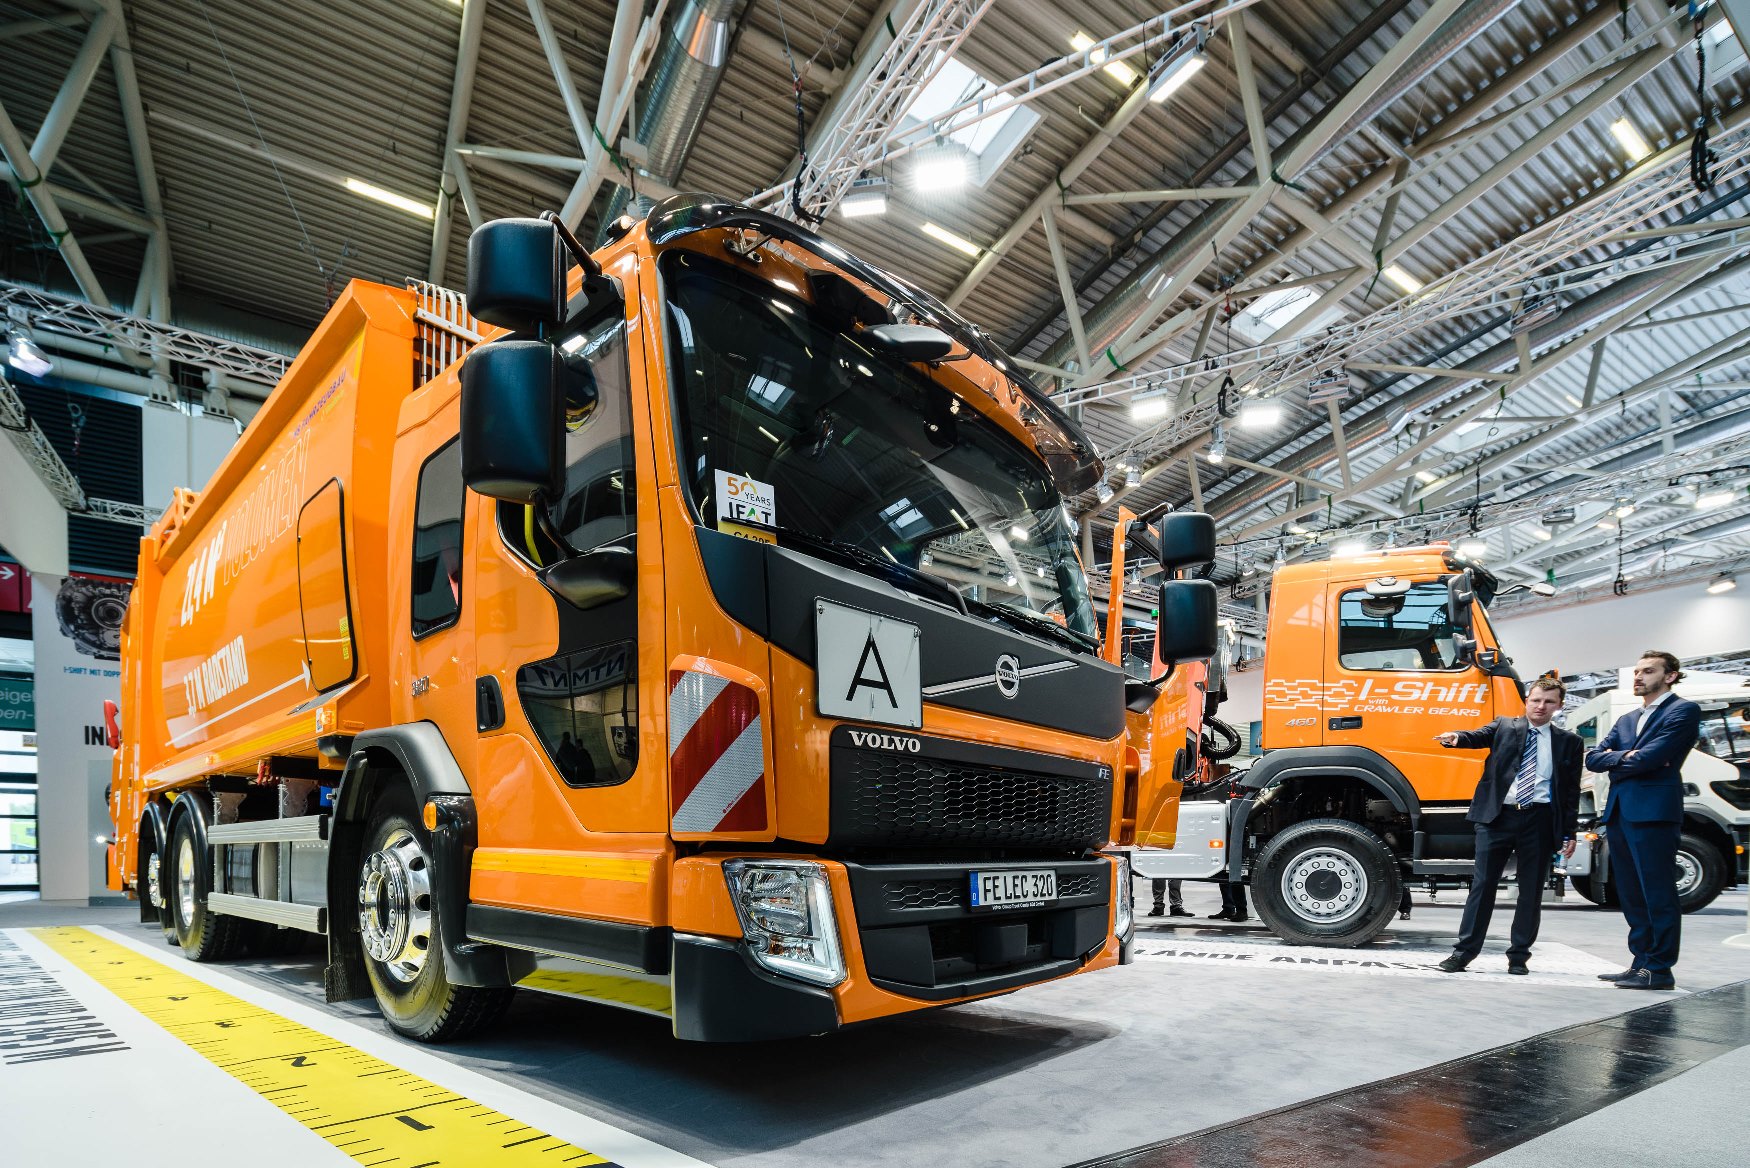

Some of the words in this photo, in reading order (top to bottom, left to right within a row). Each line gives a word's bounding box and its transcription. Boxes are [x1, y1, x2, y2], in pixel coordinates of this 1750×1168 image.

[744, 491, 771, 507] YEARS
[202, 634, 249, 705] RADSTAND
[846, 630, 899, 709] A
[997, 668, 1020, 682] VOLVO
[1358, 678, 1490, 704] I-Shift
[1367, 697, 1389, 705] with
[1353, 704, 1424, 714] CRAWLER
[1428, 707, 1481, 717] GEARS
[1284, 717, 1317, 728] 460
[848, 730, 921, 753] VOLVO
[1098, 767, 1111, 780] FE
[983, 875, 1001, 902] FE
[1003, 874, 1029, 900] LEC
[1031, 873, 1054, 898] 320
